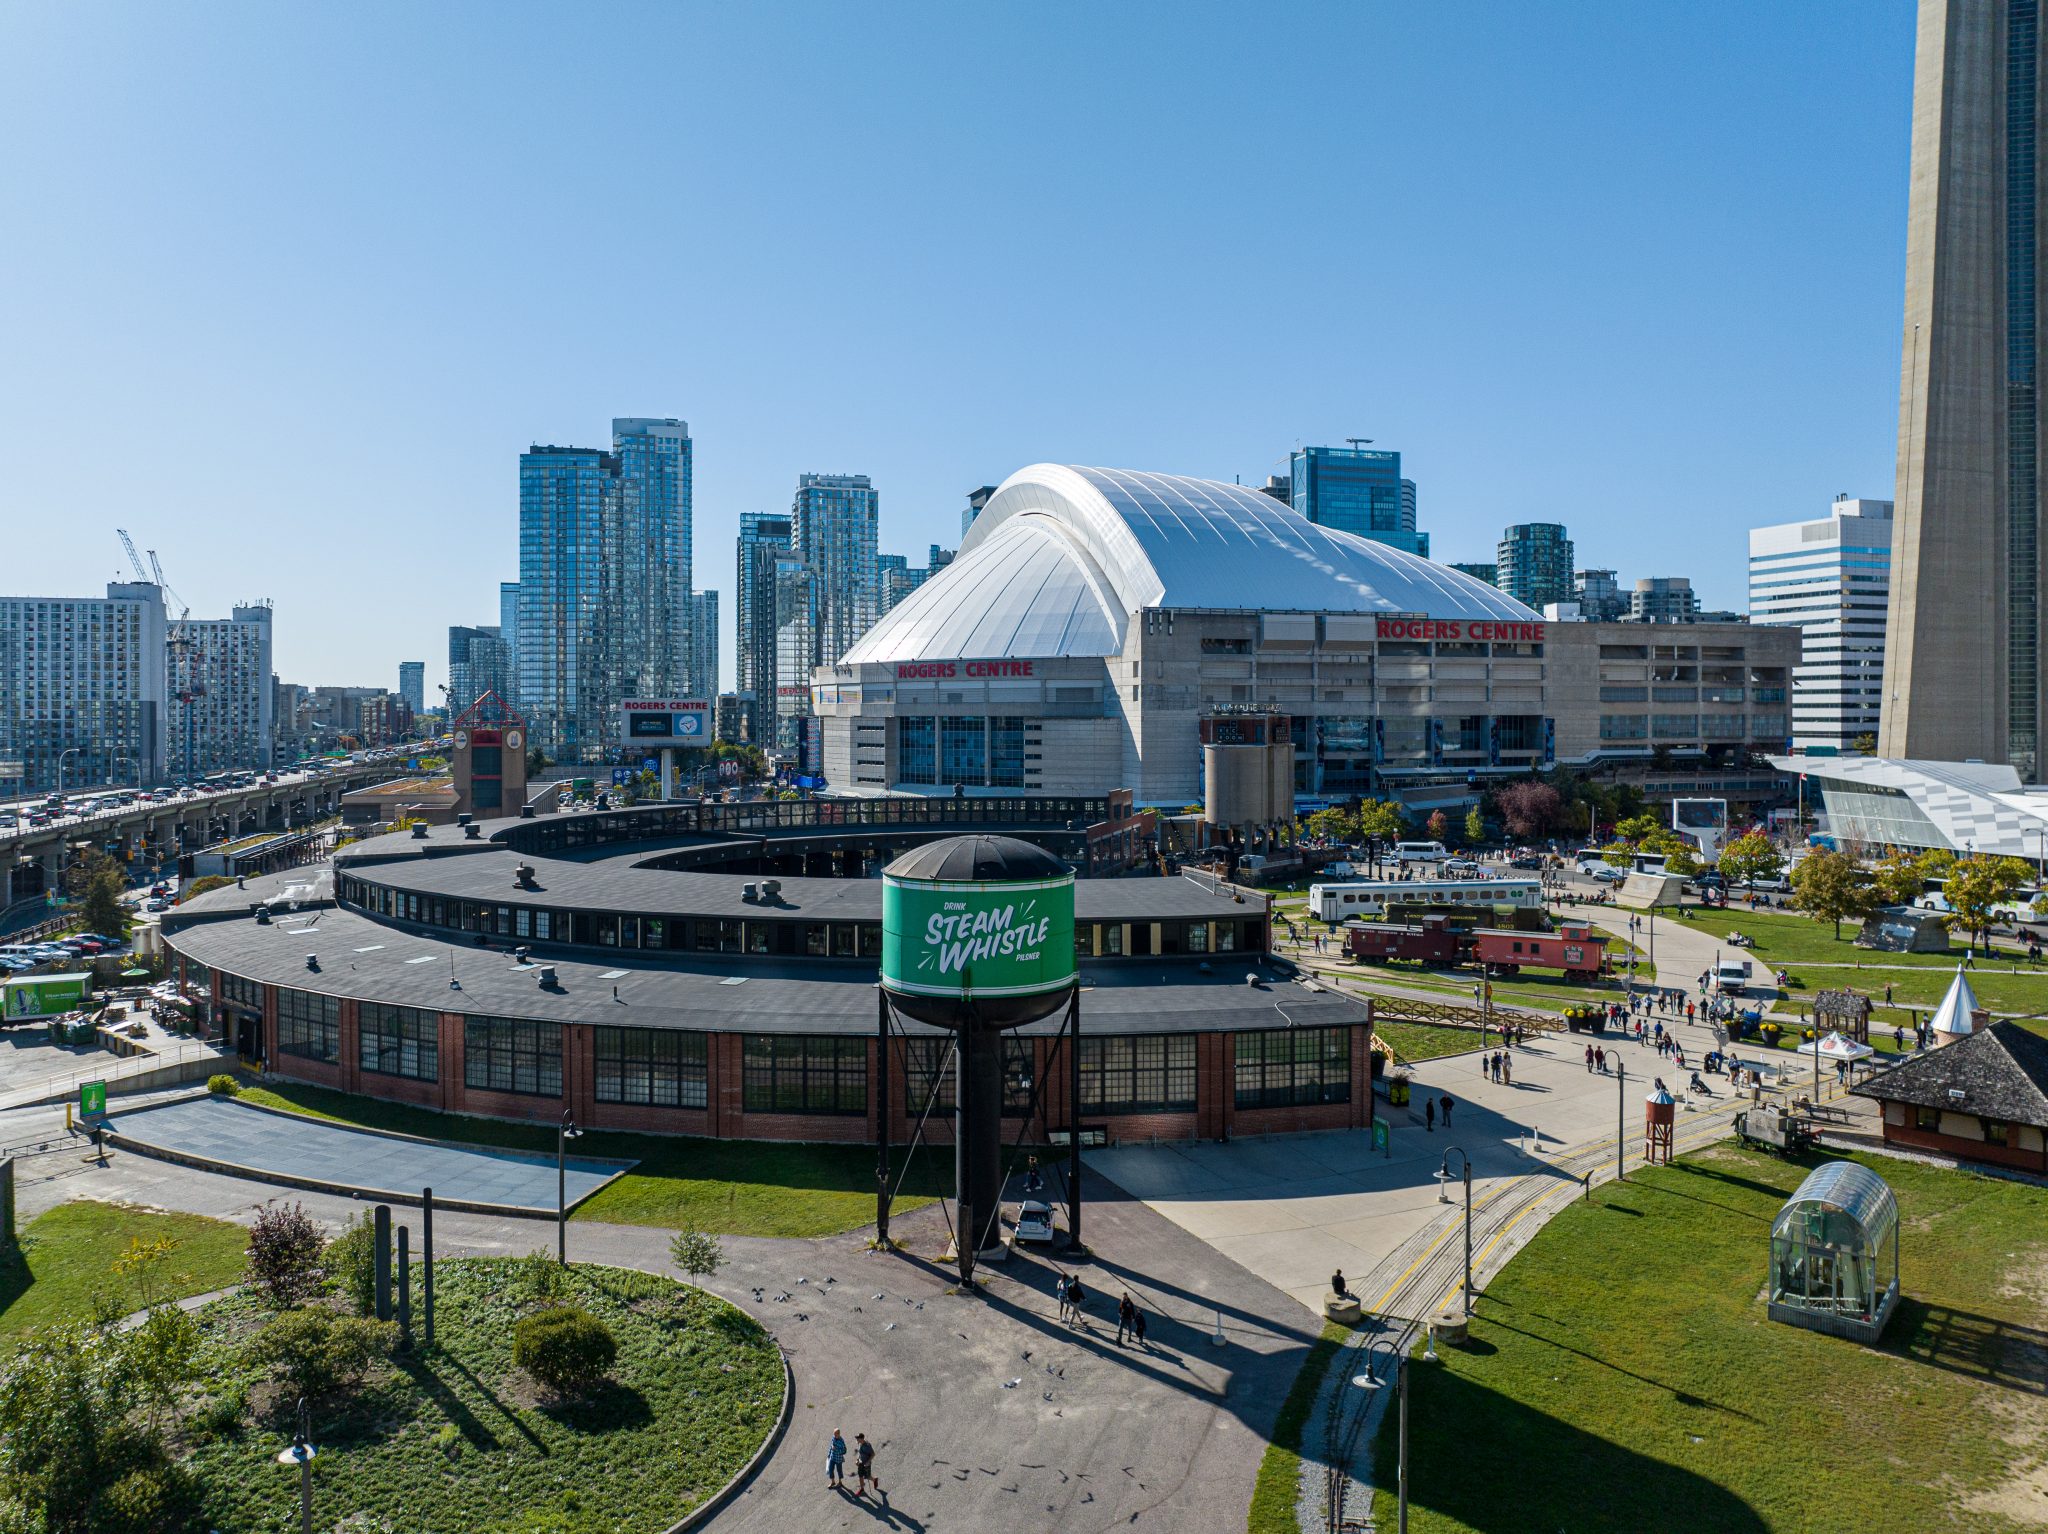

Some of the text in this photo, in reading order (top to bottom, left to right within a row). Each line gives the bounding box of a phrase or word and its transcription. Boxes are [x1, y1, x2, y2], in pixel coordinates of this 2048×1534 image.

[1376, 620, 1545, 640] ROGERS CENTRE
[897, 661, 1033, 678] ROGERS CENTRE
[624, 702, 708, 710] ROGERS CENTRE
[943, 902, 967, 911] DRINK
[924, 904, 1015, 945] STEAM
[939, 916, 1050, 974] WHISTLE
[1015, 951, 1041, 962] PILSNER
